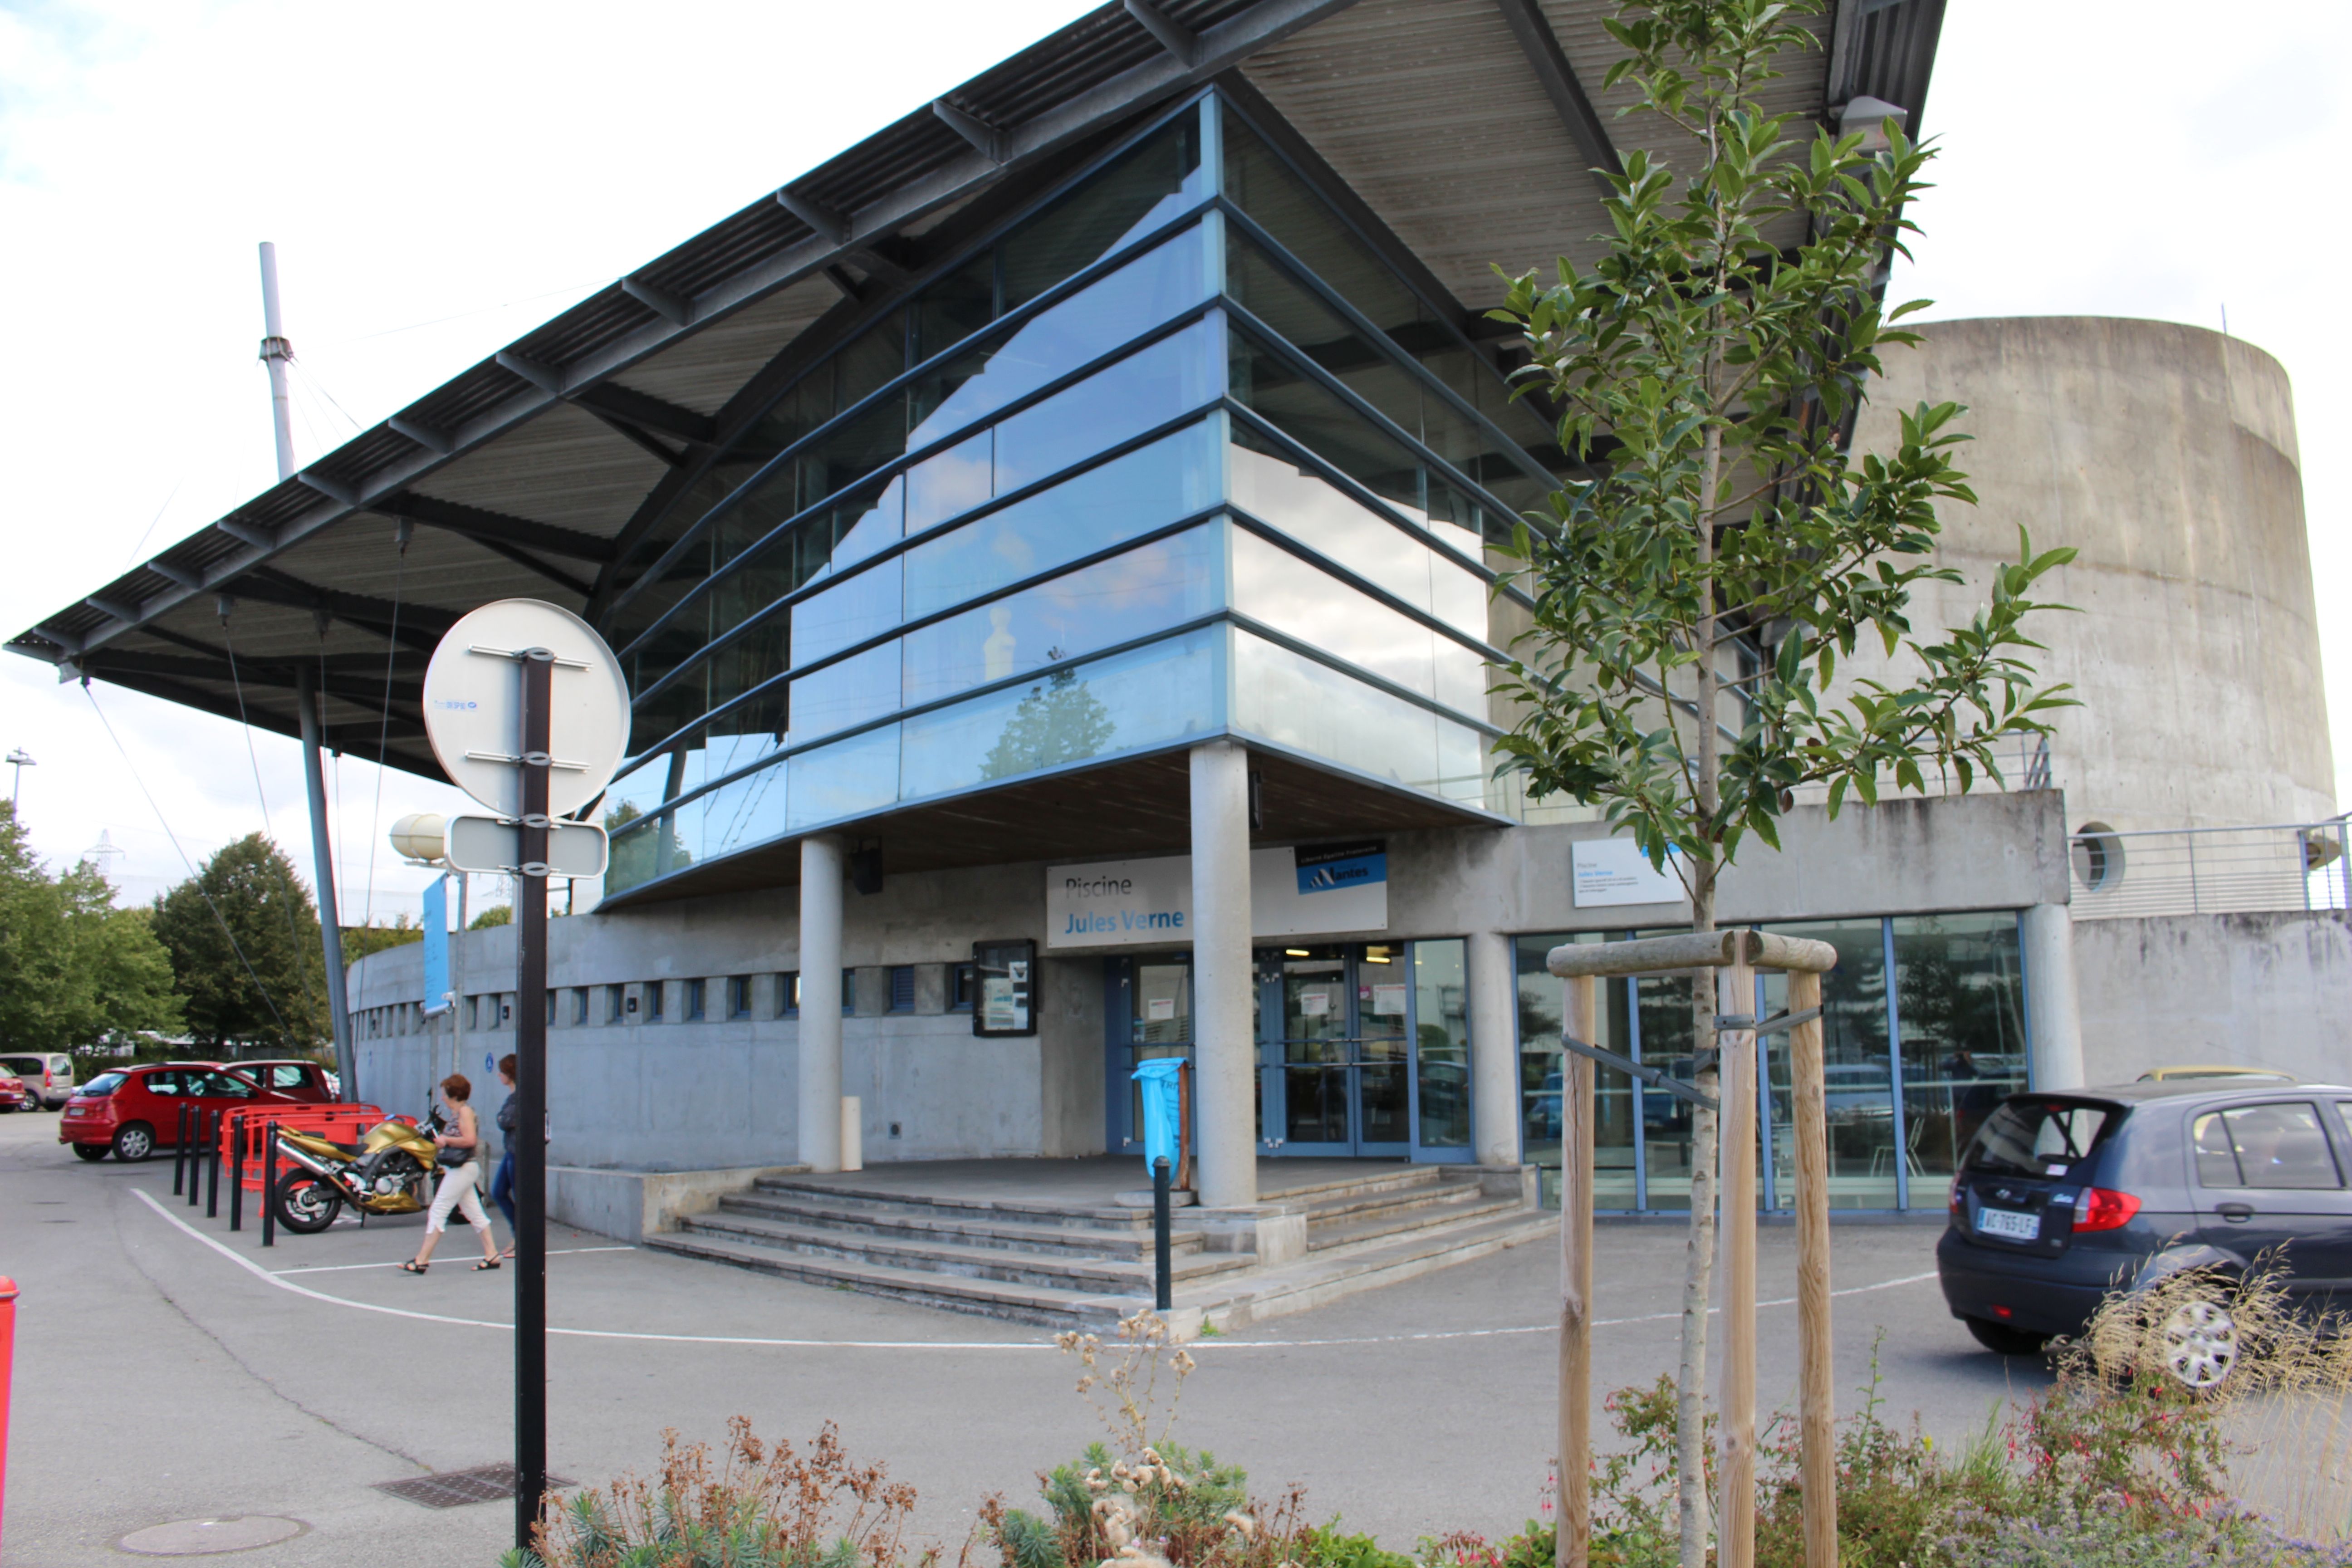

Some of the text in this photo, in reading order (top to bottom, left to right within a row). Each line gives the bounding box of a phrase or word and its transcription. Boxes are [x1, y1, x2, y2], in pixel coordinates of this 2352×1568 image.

[1065, 875, 1132, 899] Piscine
[1065, 909, 1185, 935] Jules Verne
